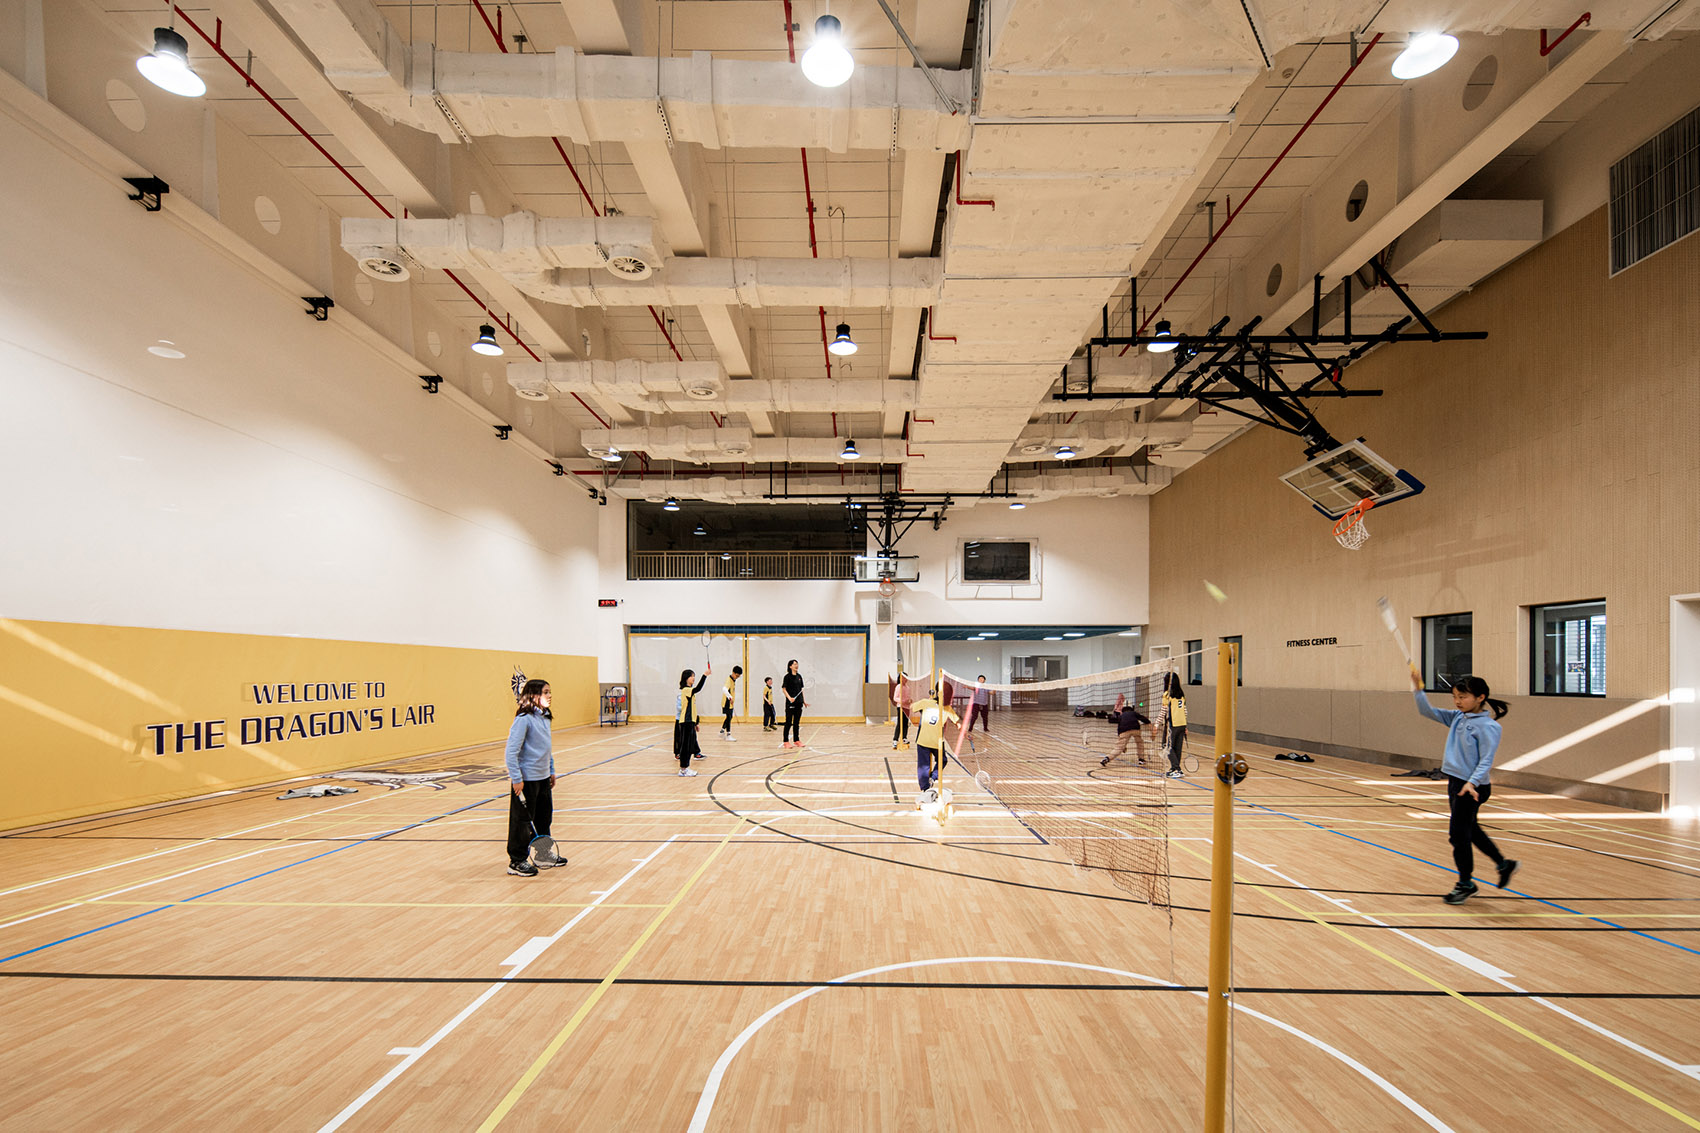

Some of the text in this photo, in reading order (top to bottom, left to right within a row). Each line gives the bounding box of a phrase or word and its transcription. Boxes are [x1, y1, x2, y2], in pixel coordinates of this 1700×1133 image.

[1311, 637, 1337, 645] CENTER
[253, 681, 386, 704] WELCOME TO
[929, 715, 938, 725] 9
[146, 704, 435, 756] THE DRAGON'S LAIR
